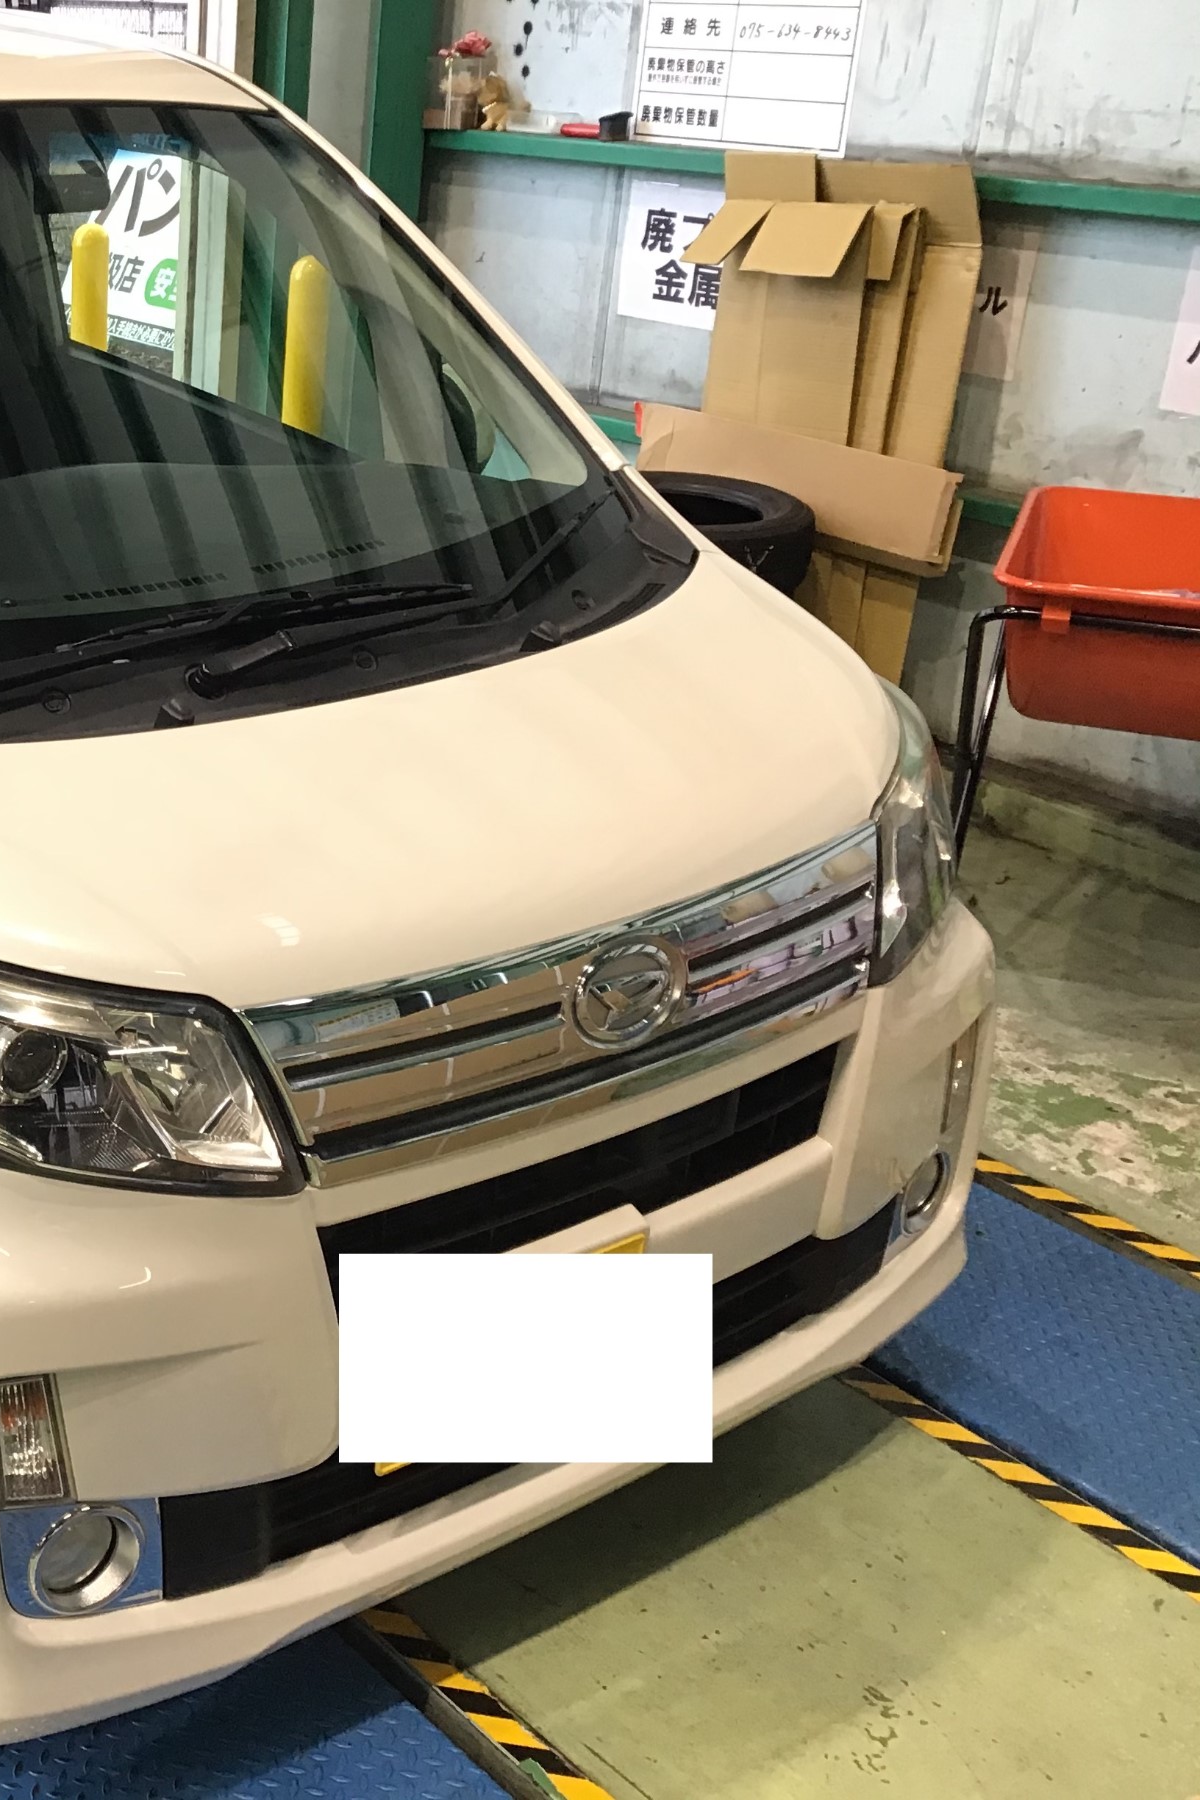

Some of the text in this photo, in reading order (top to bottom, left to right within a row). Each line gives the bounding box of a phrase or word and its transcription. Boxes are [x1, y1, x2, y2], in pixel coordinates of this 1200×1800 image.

[660, 17, 721, 37] 連絡先
[739, 22, 852, 41] 075-634-8443
[647, 57, 726, 75] 廃棄物保管の高さ
[641, 105, 719, 128] 廃棄物保管数量
[94, 158, 180, 237] パン
[652, 259, 722, 310] 金属
[978, 286, 1008, 316] ル
